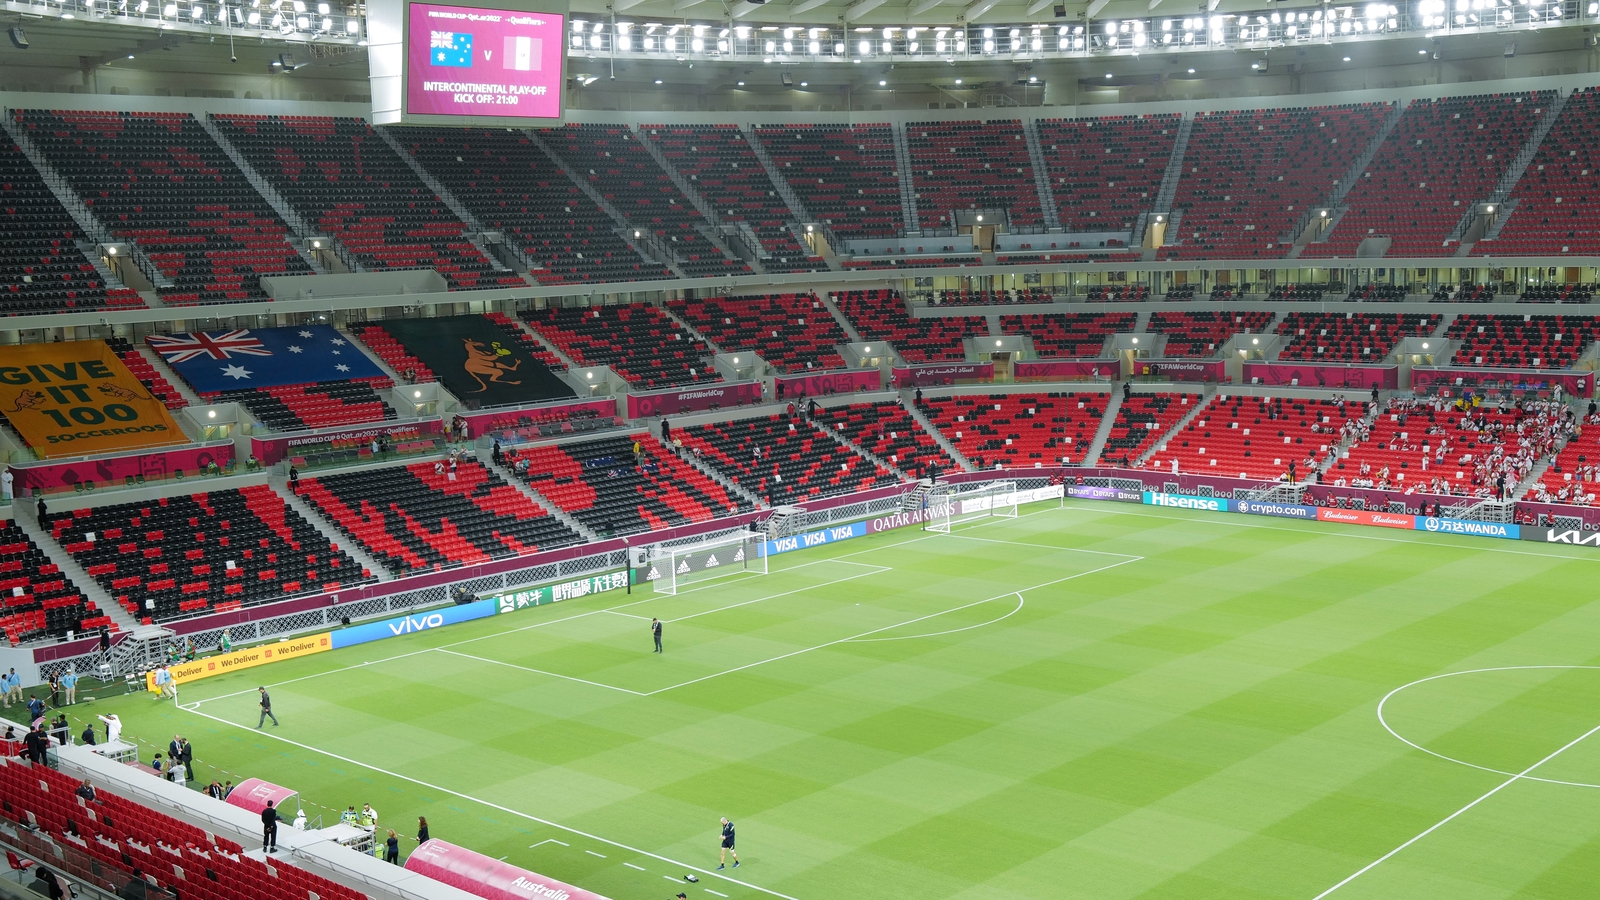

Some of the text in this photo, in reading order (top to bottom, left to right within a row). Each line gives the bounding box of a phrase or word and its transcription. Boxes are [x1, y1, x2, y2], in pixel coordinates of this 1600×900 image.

[424, 81, 547, 96] INTERCONTINENTAL PLAY-OFF
[454, 93, 518, 105] KICK OFF: 21:00
[0, 360, 115, 385] GIVE
[44, 384, 93, 404] IT
[678, 389, 724, 400] #FIFAWorldCup
[40, 403, 139, 428] 100
[46, 424, 168, 444] SOCCEROOS
[301, 437, 323, 446] WORLD
[324, 435, 335, 443] CUP
[1152, 492, 1218, 510] Hisense
[1251, 503, 1306, 516] crypto.com
[1323, 510, 1358, 520] Budweiser
[873, 512, 909, 532] QATAR
[912, 503, 955, 522] AIRWAYS
[1371, 515, 1408, 525] Budweiser
[803, 531, 826, 546] VISA
[830, 526, 853, 540] VISA
[774, 538, 798, 552] VISA
[516, 590, 542, 609] 蒙牛
[388, 613, 443, 635] vivo
[277, 642, 315, 655] We Deliver
[221, 653, 259, 668] We Deliver
[177, 666, 202, 678] Deliver
[511, 876, 570, 900] Australia
